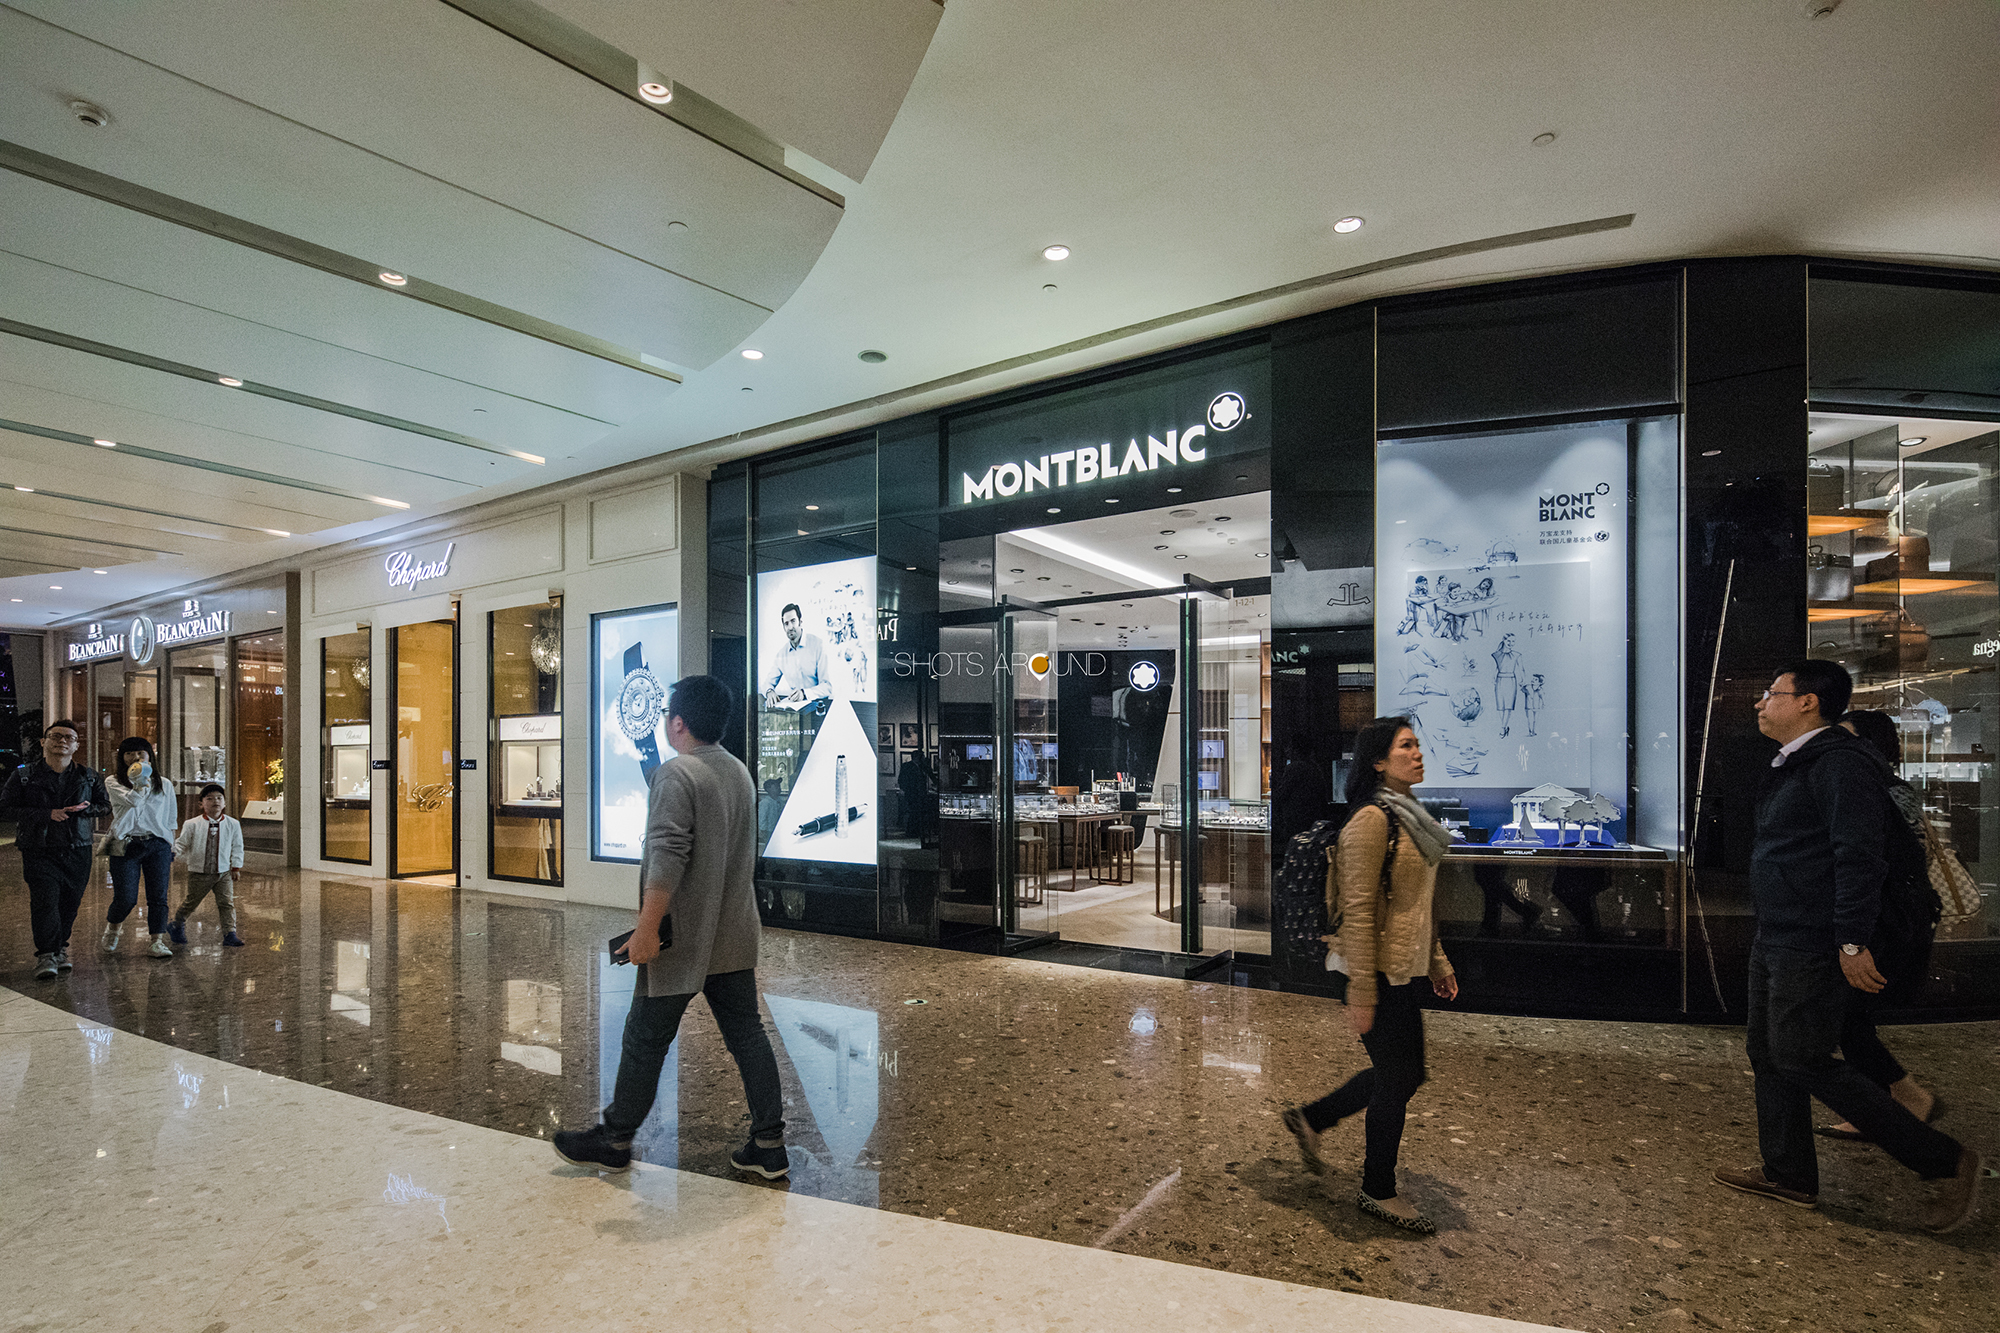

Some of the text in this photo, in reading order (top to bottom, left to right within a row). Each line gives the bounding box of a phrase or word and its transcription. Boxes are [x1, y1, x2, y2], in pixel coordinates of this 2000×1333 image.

[963, 424, 1206, 504] MONTBLANC
[1539, 492, 1595, 508] MONT
[1539, 506, 1595, 522] BLANC
[1539, 536, 1593, 545] 联合国儿童基金会
[385, 542, 453, 591] Chopard
[156, 610, 223, 643] BLANCPAIN
[69, 634, 119, 661] BLANCPAIN
